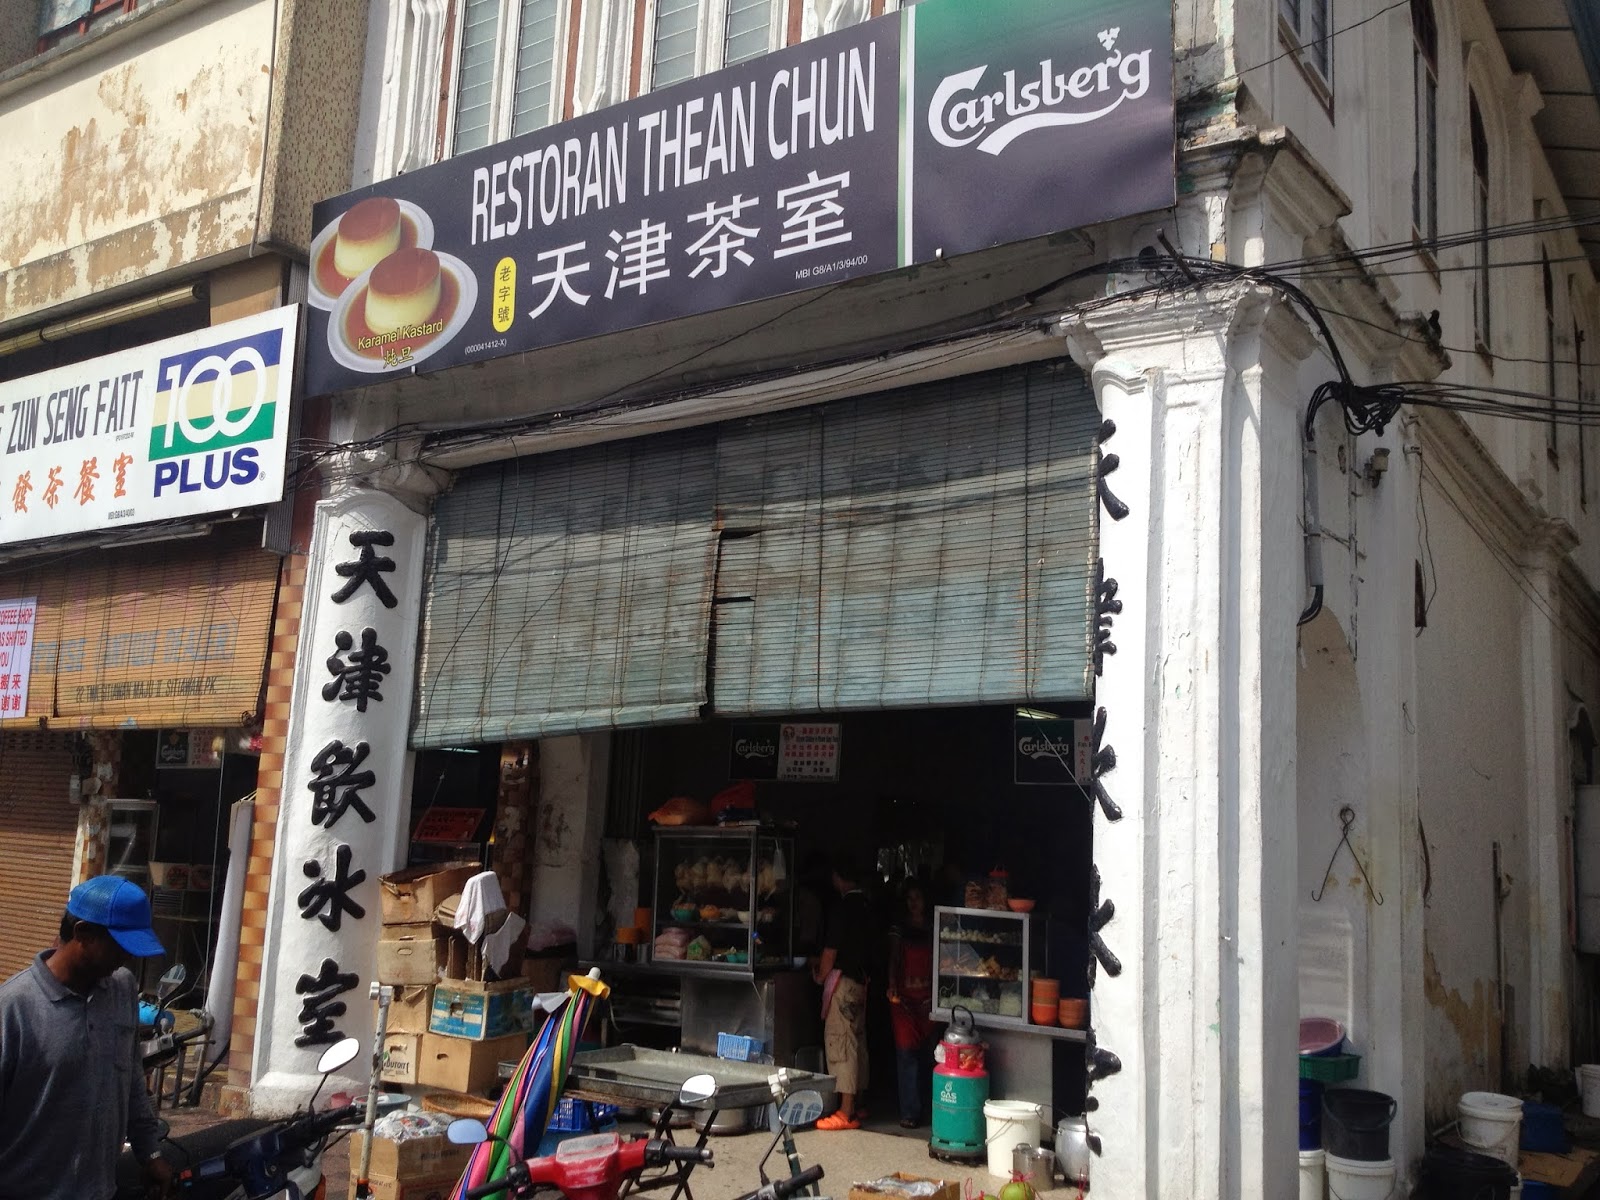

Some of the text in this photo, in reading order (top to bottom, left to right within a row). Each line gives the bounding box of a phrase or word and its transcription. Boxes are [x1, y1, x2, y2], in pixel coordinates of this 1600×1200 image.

[928, 46, 1152, 154] Carlsberg
[471, 41, 876, 246] RESTORAN THEAN CHUN
[528, 170, 853, 320] 天津茶室
[795, 254, 868, 280] MBI G8/A1/3/94/00
[498, 265, 512, 323] 老字號
[357, 318, 444, 351] Karamel Kastard
[464, 339, 508, 356] (000041412-X)
[6, 395, 42, 455] ZUN
[43, 383, 90, 446] SENG
[93, 370, 144, 436] FATT
[163, 346, 268, 449] 100
[153, 446, 260, 498] PLUS
[0, 652, 9, 668] OU
[1018, 736, 1069, 760] Carlsberg
